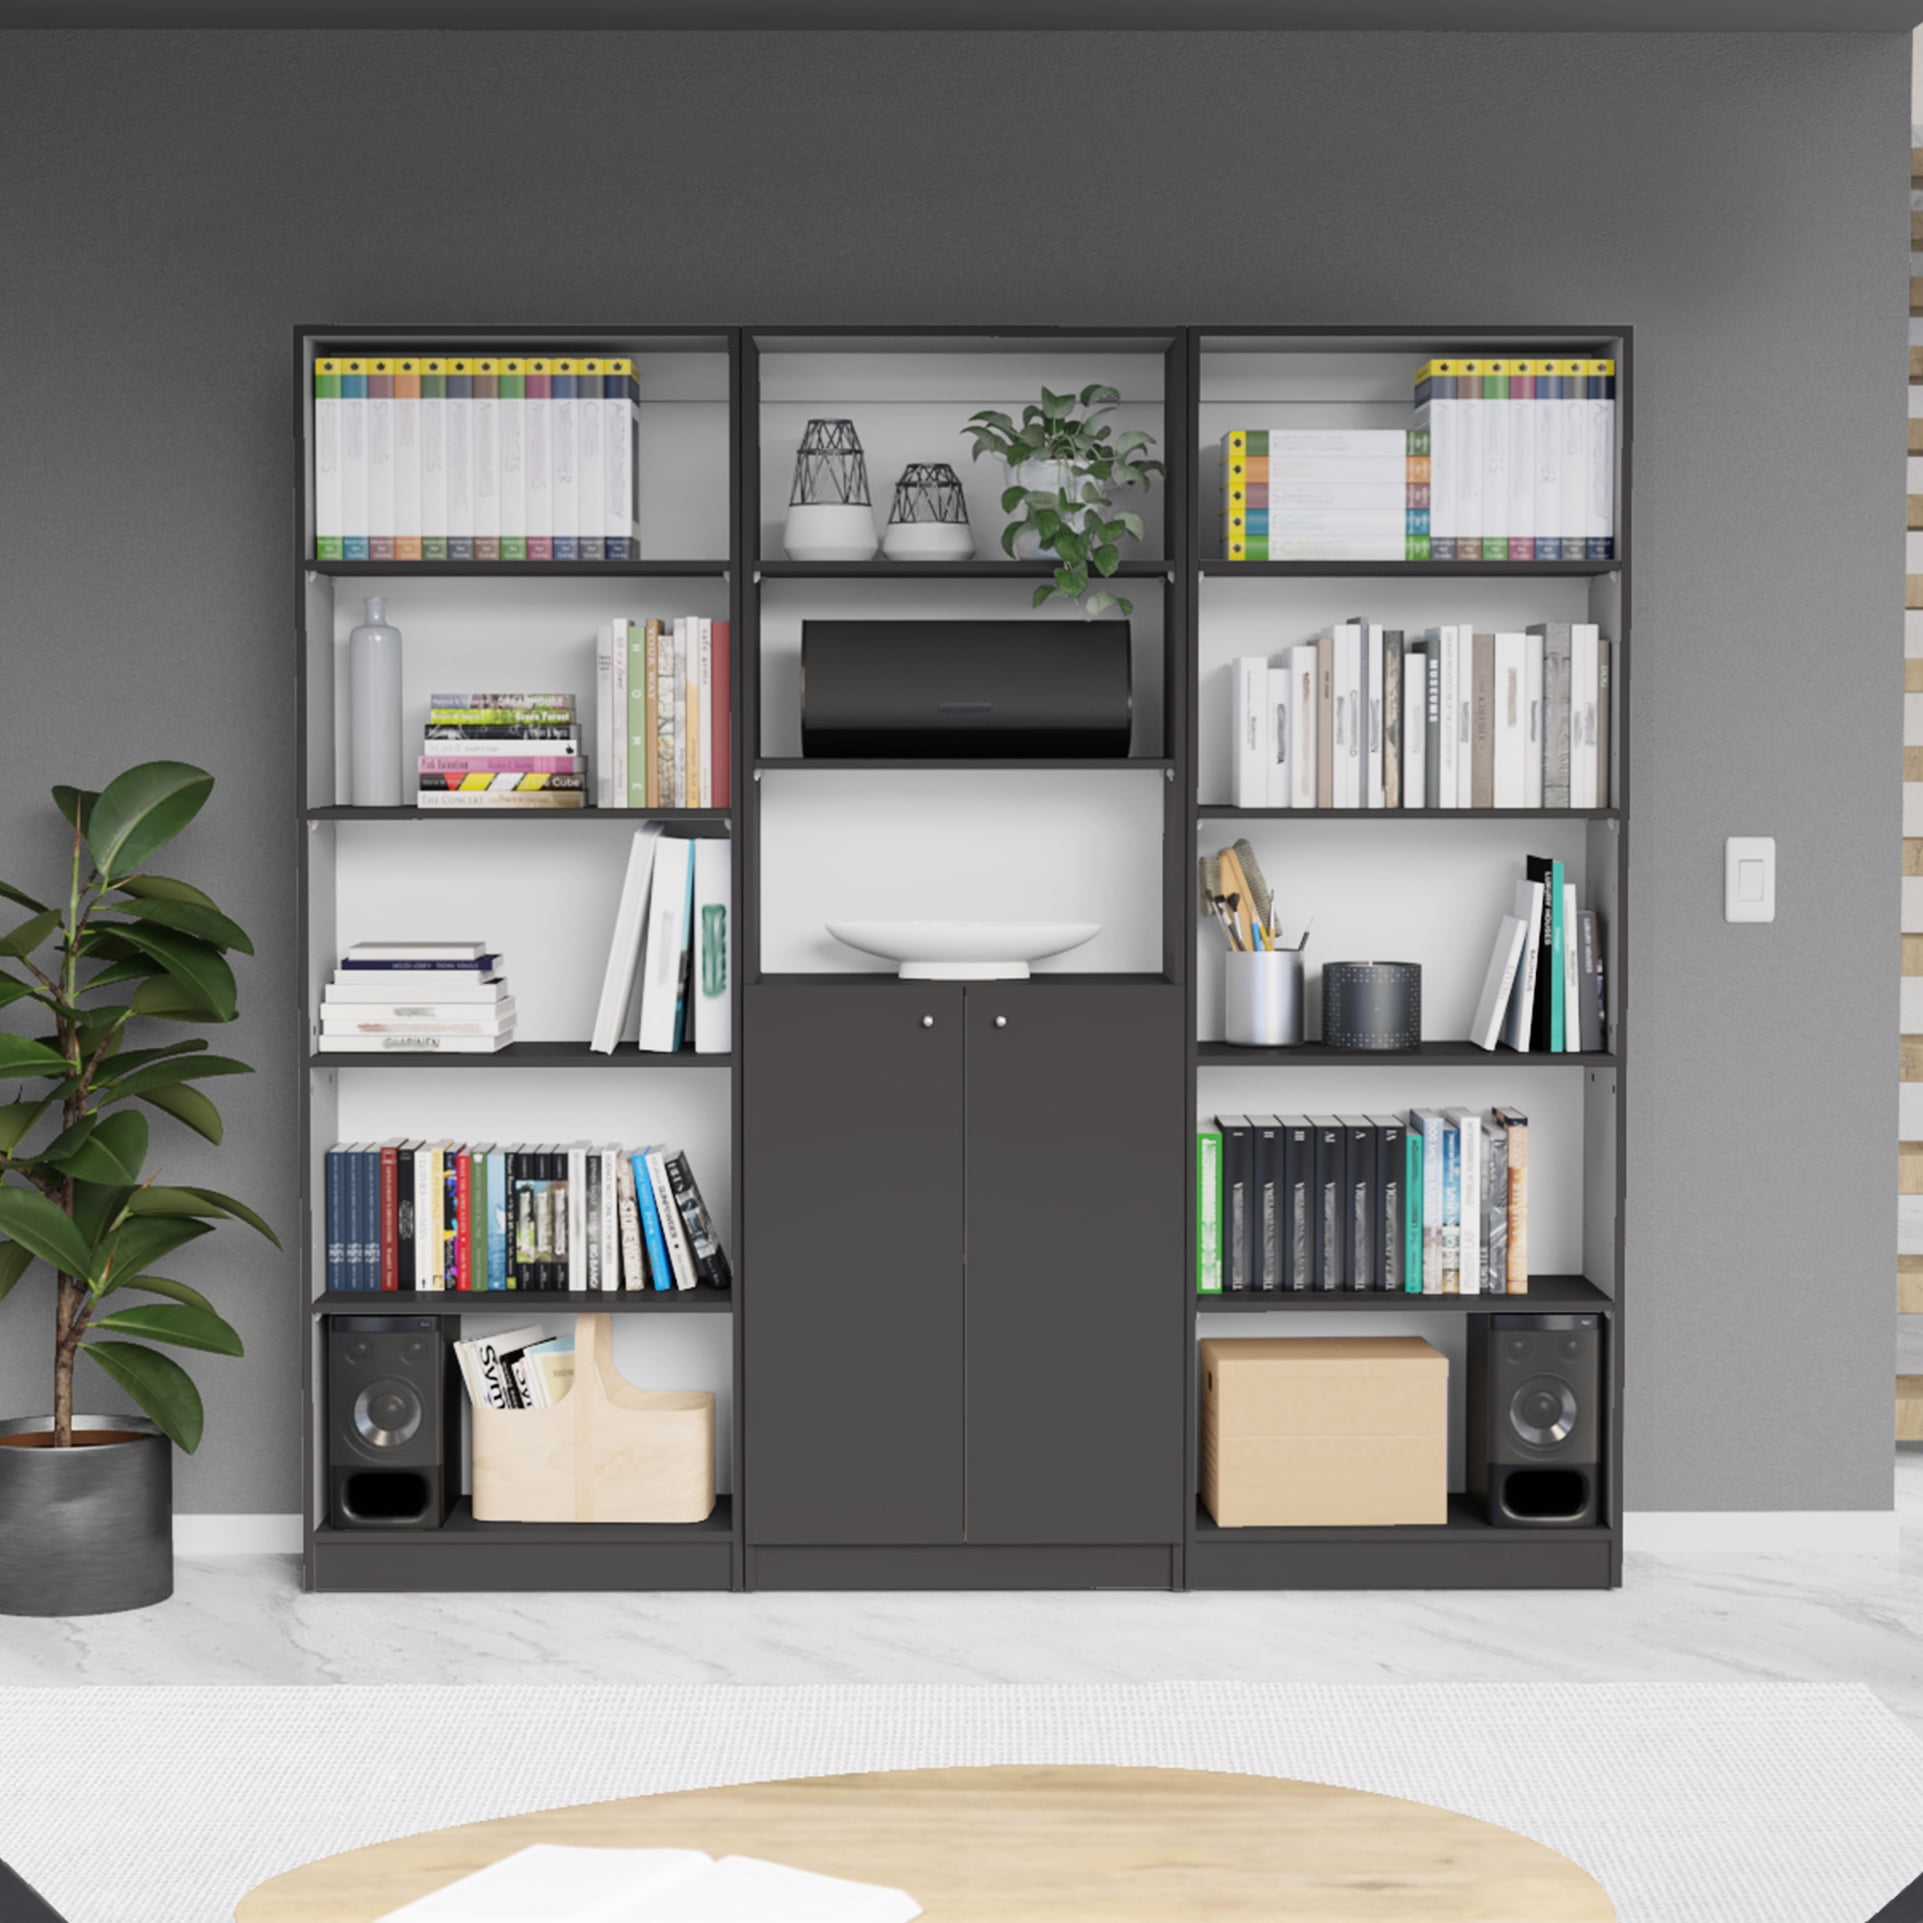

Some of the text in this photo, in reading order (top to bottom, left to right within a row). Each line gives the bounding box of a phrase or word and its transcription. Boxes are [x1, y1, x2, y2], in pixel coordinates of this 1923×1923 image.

[647, 627, 656, 700] YOUR WAY
[632, 643, 642, 790] HOME
[1429, 659, 1439, 723] MUSEUMS
[552, 777, 580, 787] Cube
[1544, 908, 1552, 946] HOUSES
[1585, 945, 1593, 974] HOUSES
